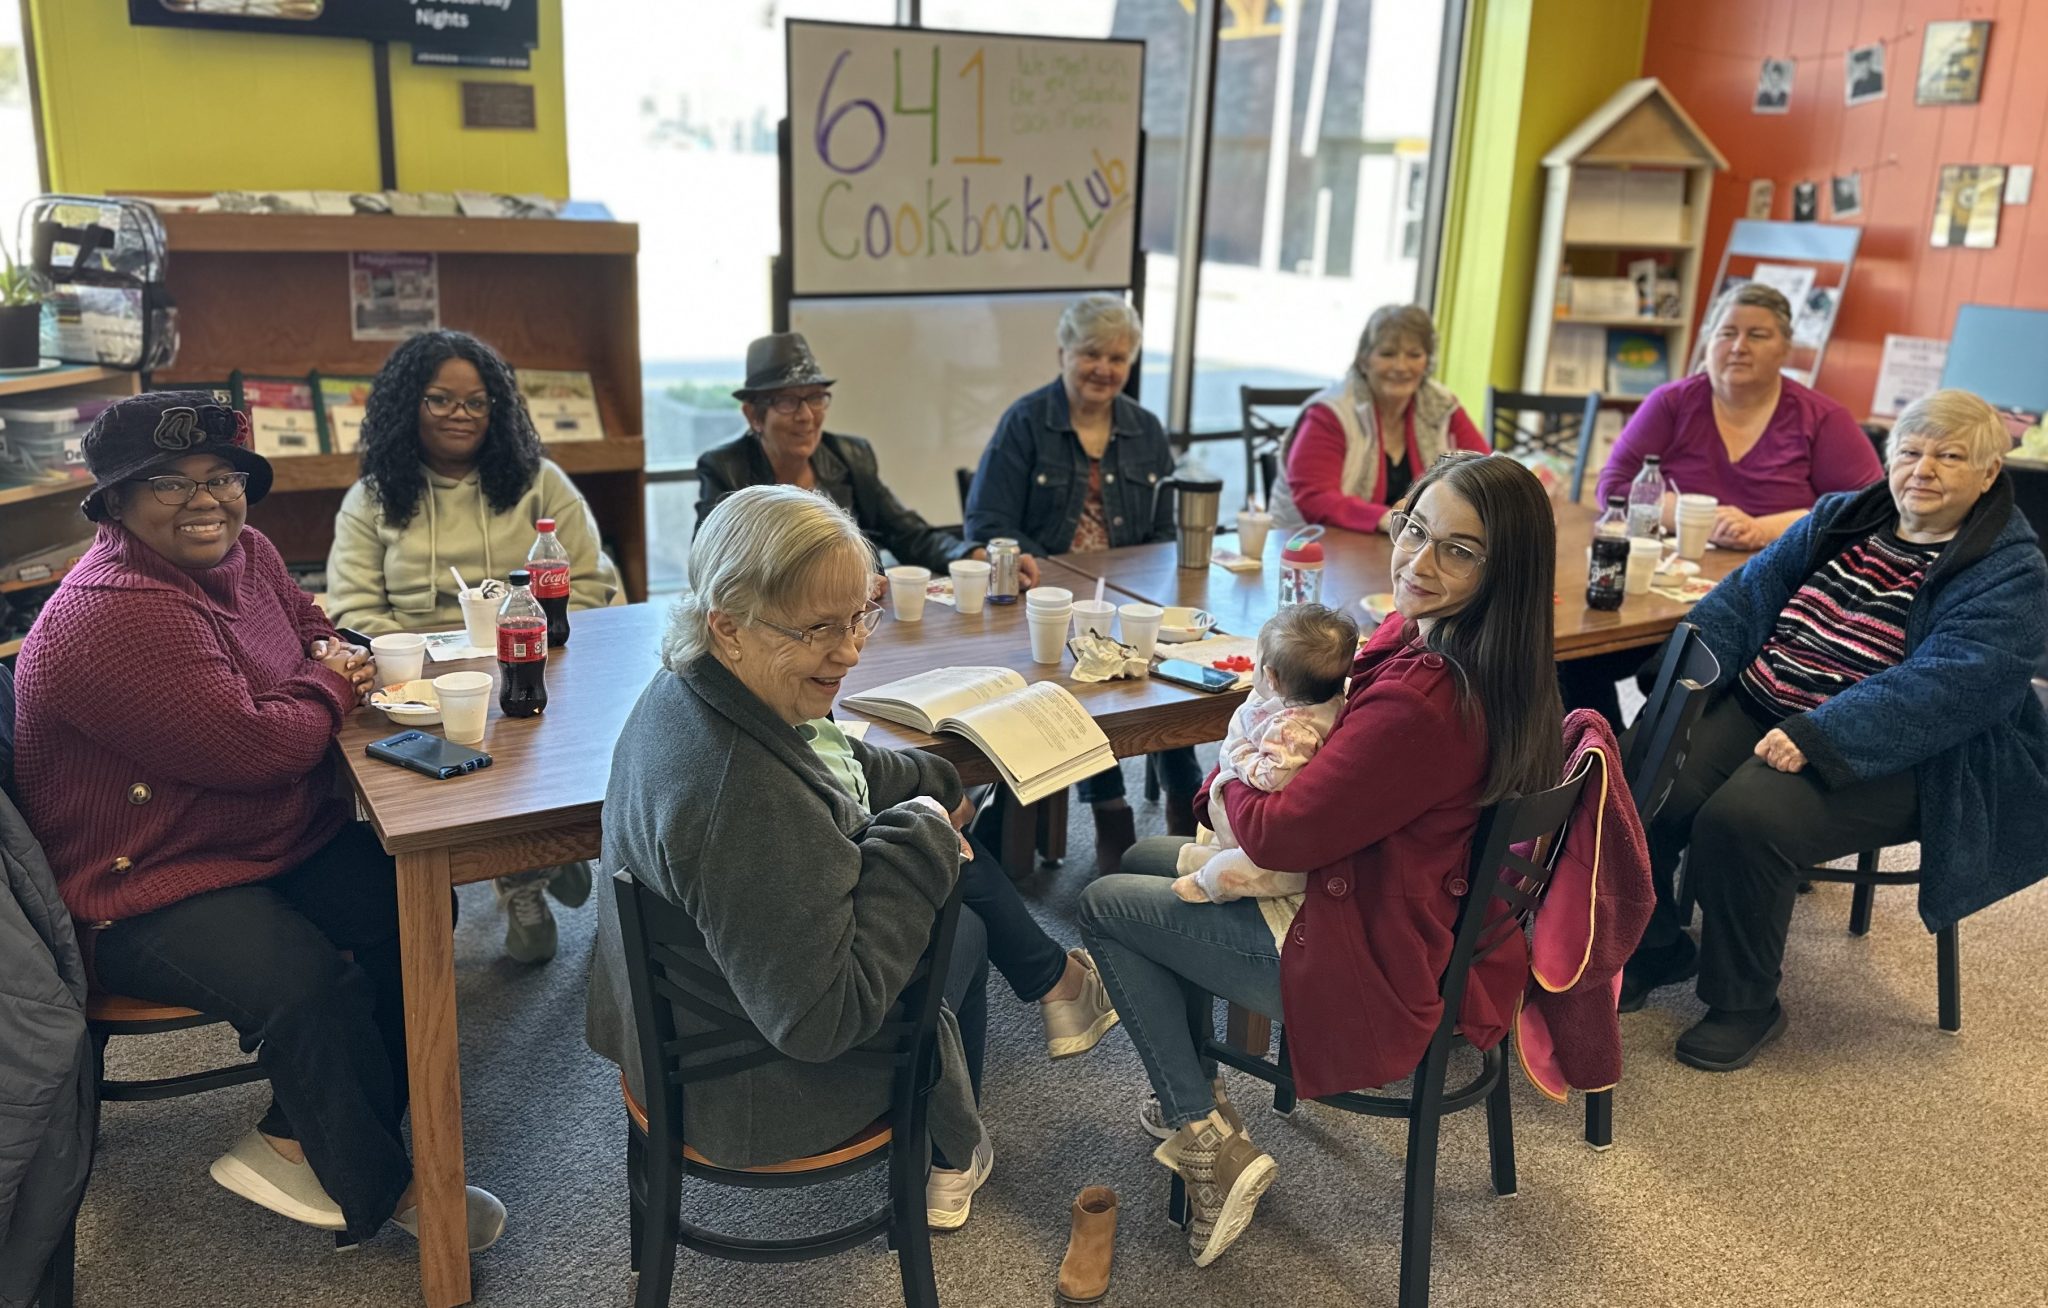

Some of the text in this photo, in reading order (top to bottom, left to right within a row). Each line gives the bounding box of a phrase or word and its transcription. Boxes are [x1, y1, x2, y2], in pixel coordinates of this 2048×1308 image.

[415, 8, 470, 30] Nights
[814, 46, 1002, 175] 641
[817, 174, 1050, 261] Cookbook
